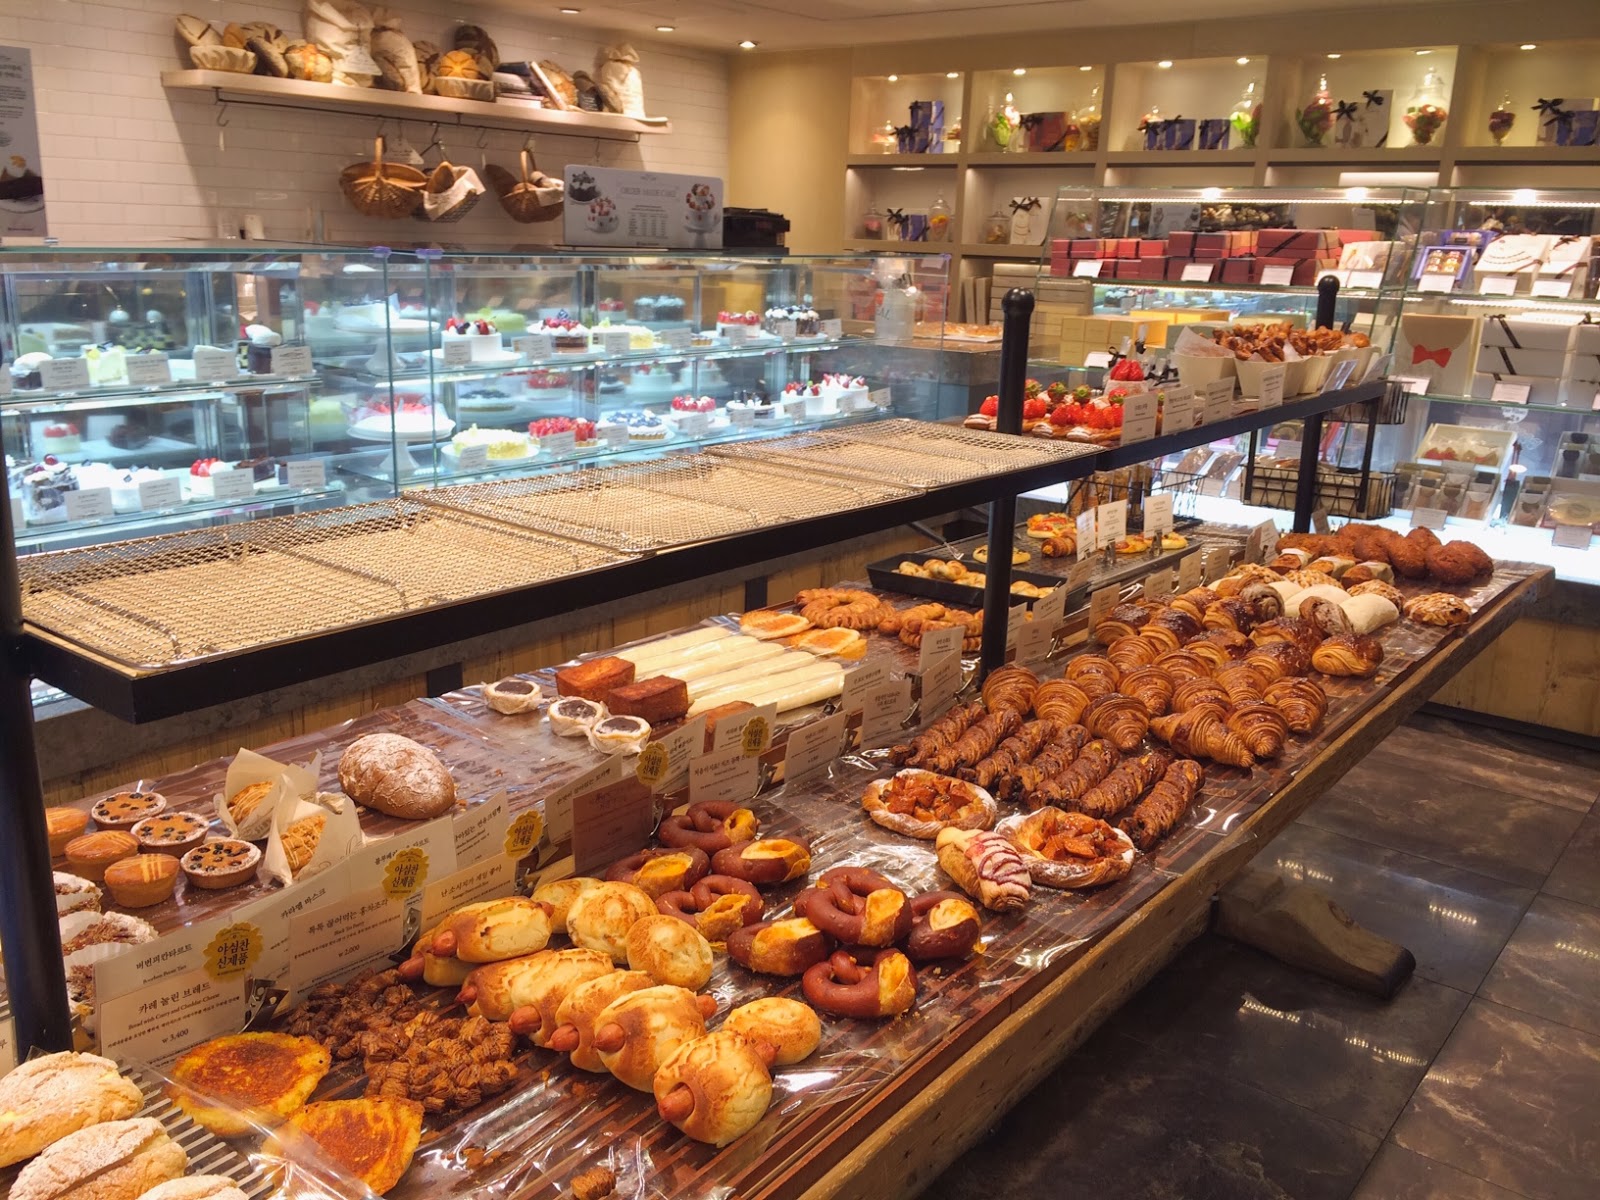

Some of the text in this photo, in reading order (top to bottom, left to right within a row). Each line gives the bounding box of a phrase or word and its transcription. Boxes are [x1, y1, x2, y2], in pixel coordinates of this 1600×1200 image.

[394, 863, 419, 876] 야심찬
[391, 876, 416, 888] 신제품
[217, 938, 250, 956] 야심찬
[216, 951, 249, 970] 신제품
[138, 999, 158, 1015] 카레
[182, 981, 212, 997] 브레드
[169, 1027, 190, 1042] 3,400
